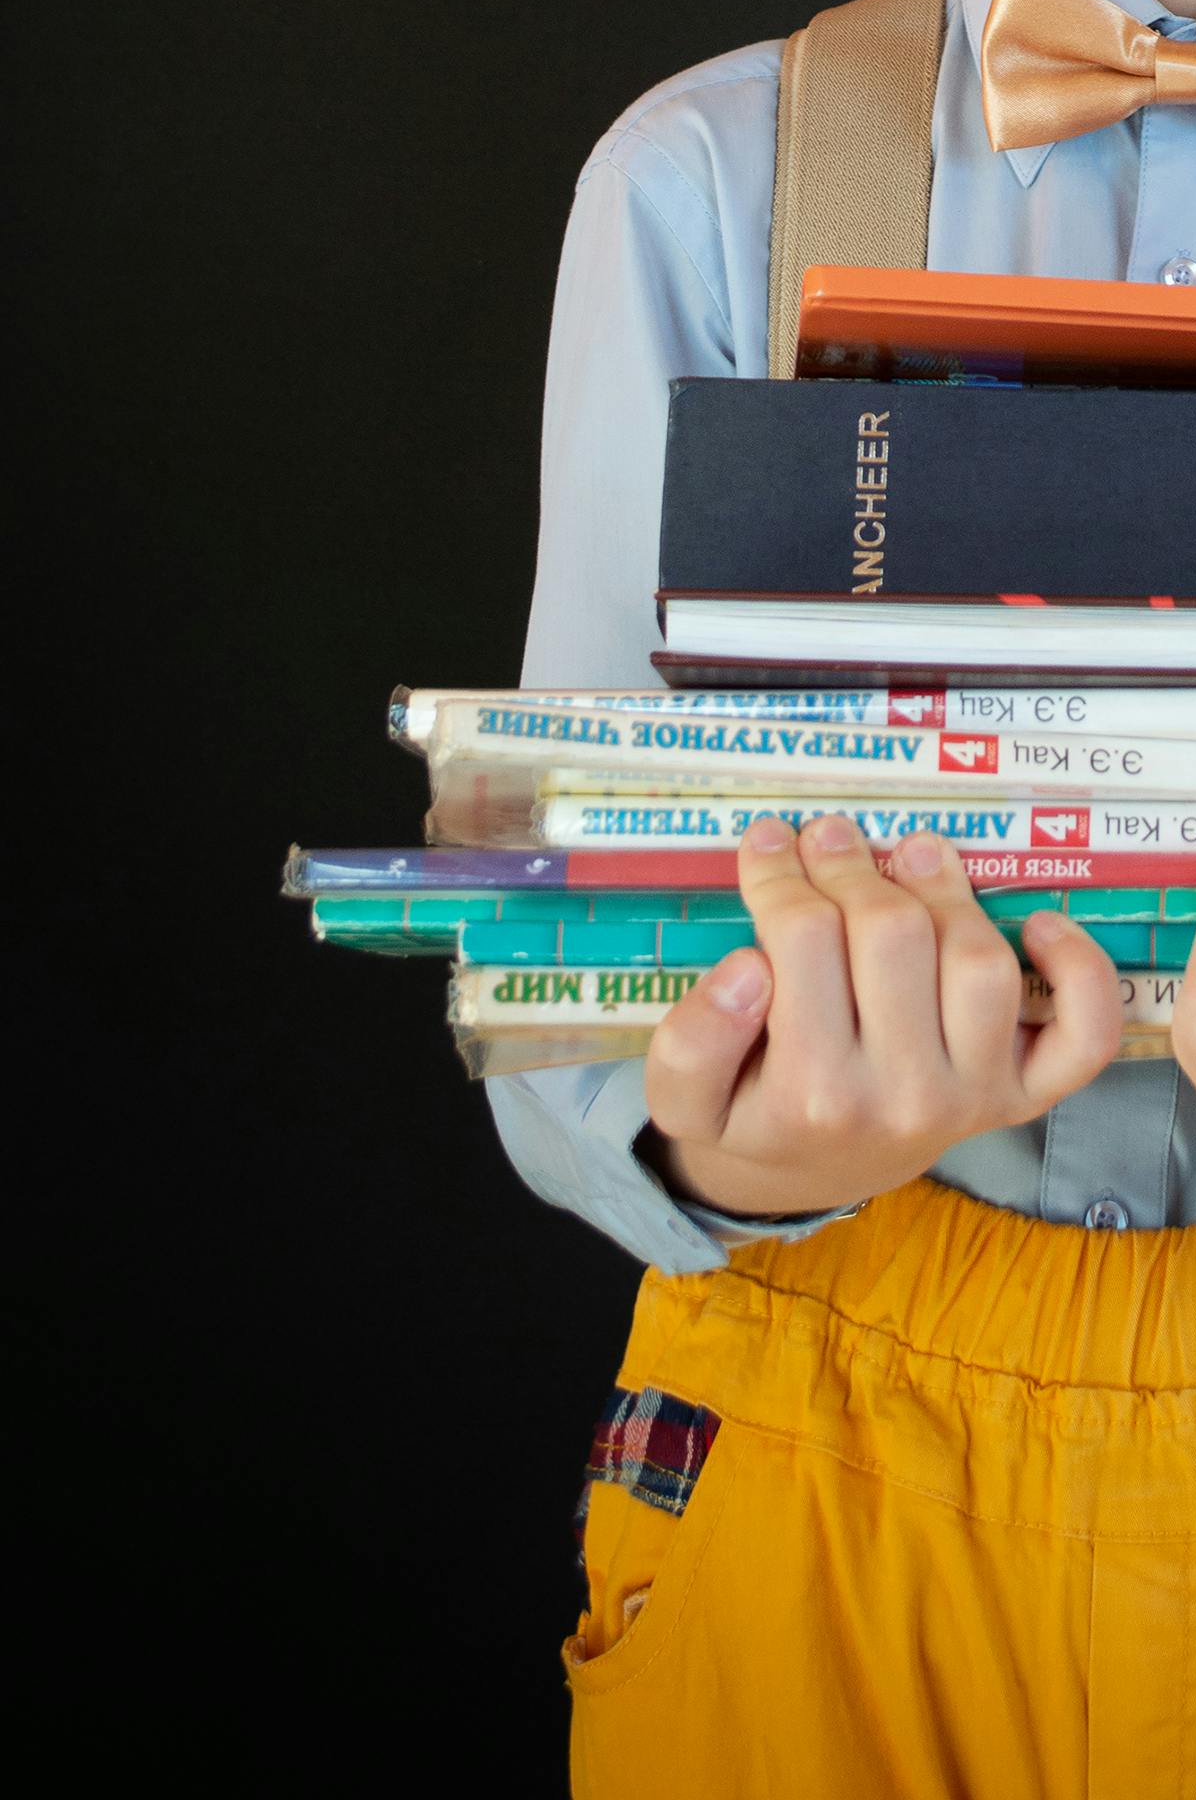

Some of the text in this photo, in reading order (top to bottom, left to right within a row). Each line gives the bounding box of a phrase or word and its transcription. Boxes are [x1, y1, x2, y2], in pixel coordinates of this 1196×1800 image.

[892, 694, 933, 721] 4
[958, 692, 1014, 721] Кац
[1026, 693, 1087, 721] Э.Э.
[476, 707, 922, 761] ЛИТЕРАТУРНОЕ ЧТЕНИЕ
[943, 739, 985, 766] 4
[1013, 741, 1068, 770] Кац
[1081, 746, 1143, 774] Э.Э.
[580, 806, 720, 835] ЧТЕНИЕ
[1035, 813, 1076, 840] 4
[1103, 811, 1160, 843] Кац
[1024, 858, 1092, 877] ЯЗЫК
[492, 971, 582, 1003] МИР
